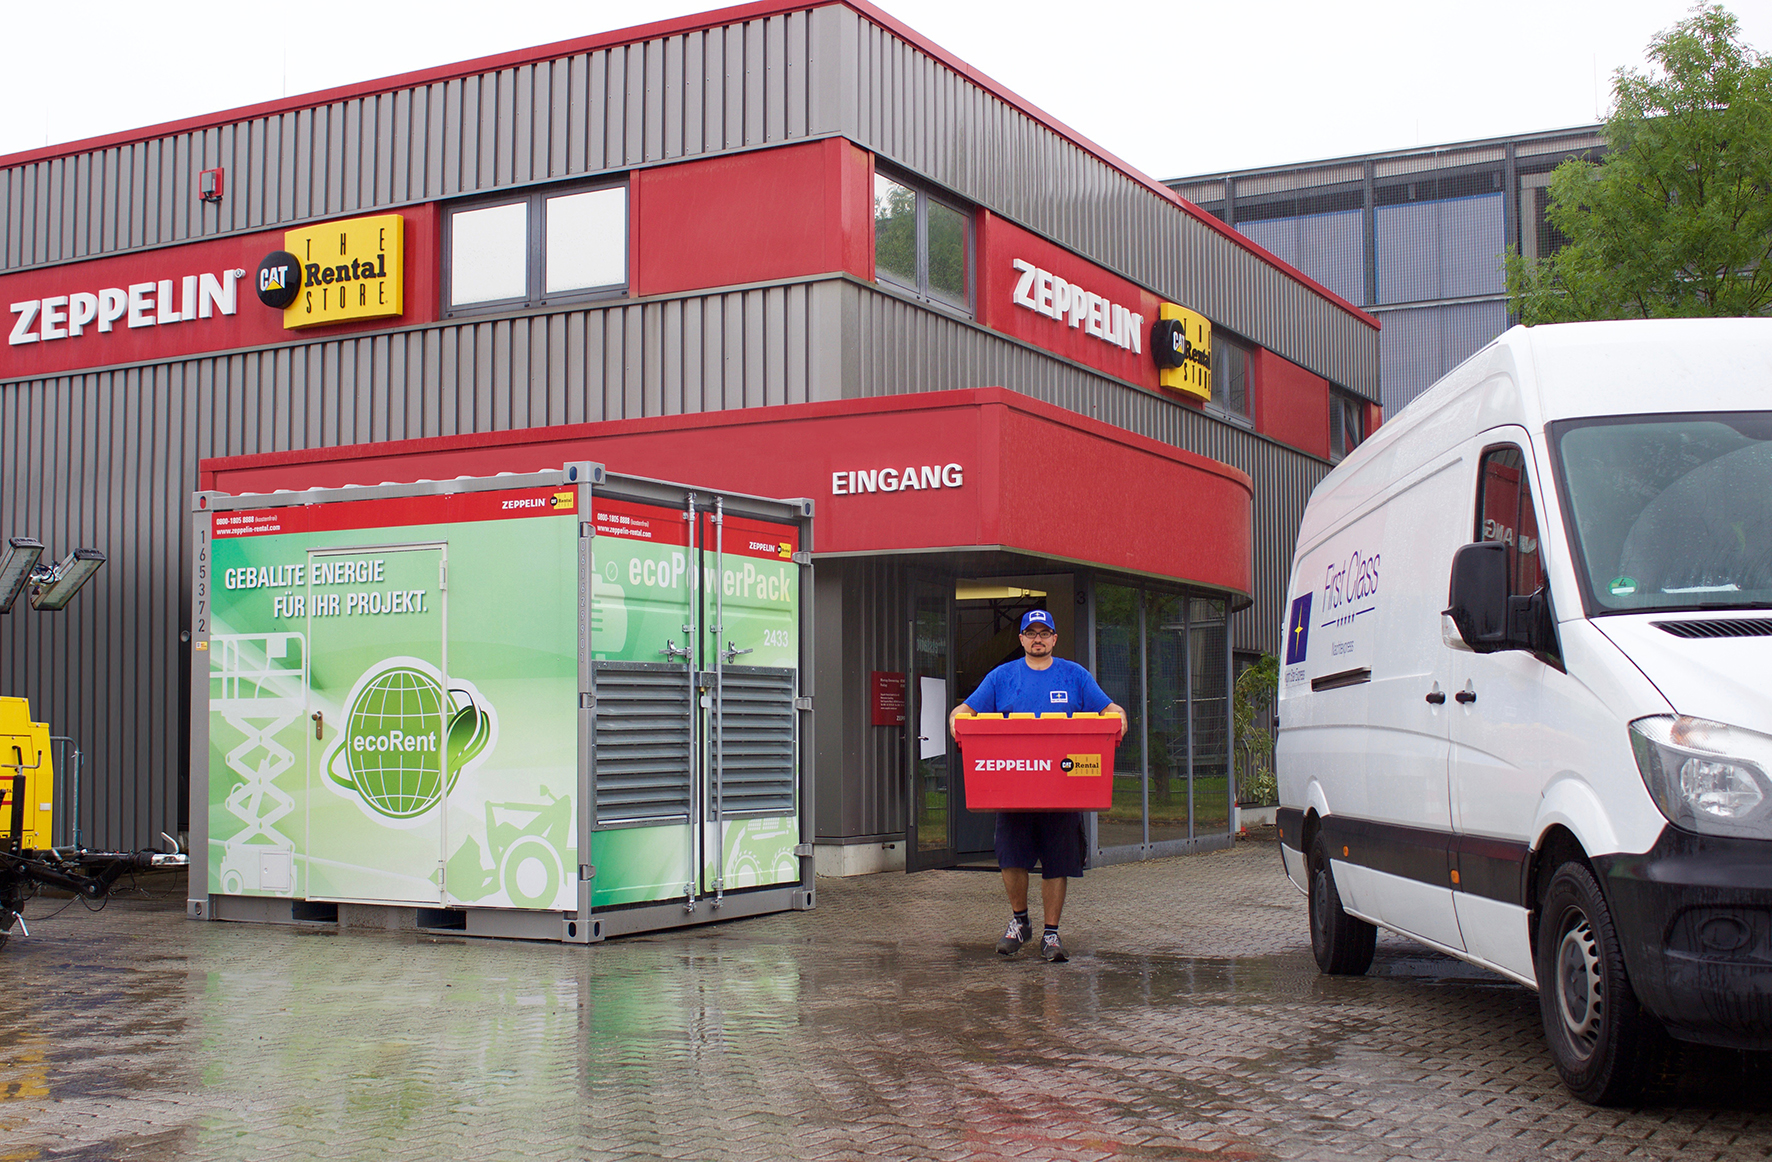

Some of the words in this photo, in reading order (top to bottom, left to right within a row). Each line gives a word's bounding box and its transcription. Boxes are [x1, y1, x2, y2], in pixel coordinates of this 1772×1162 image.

[306, 227, 385, 261] THE
[259, 265, 289, 292] CAT
[304, 253, 386, 288] Rental
[306, 281, 385, 314] STORE
[832, 463, 963, 495] EINGANG
[501, 498, 546, 510] ZEPPELIN
[216, 524, 281, 536] www.zeppelin-rental.com
[749, 541, 776, 553] ZEPPELIN
[225, 563, 306, 590] GEBALLTE
[311, 559, 385, 586] ENERGIE
[628, 551, 792, 603] ecoPowerPack
[1322, 560, 1347, 613] First
[1346, 549, 1381, 604] Class
[273, 591, 306, 618] FÜR
[311, 593, 341, 617] IHR
[346, 590, 429, 616] PROJEKT.
[763, 629, 790, 648] 2433
[353, 730, 437, 752] ecoRent
[974, 759, 1052, 772] ZEPPELIN
